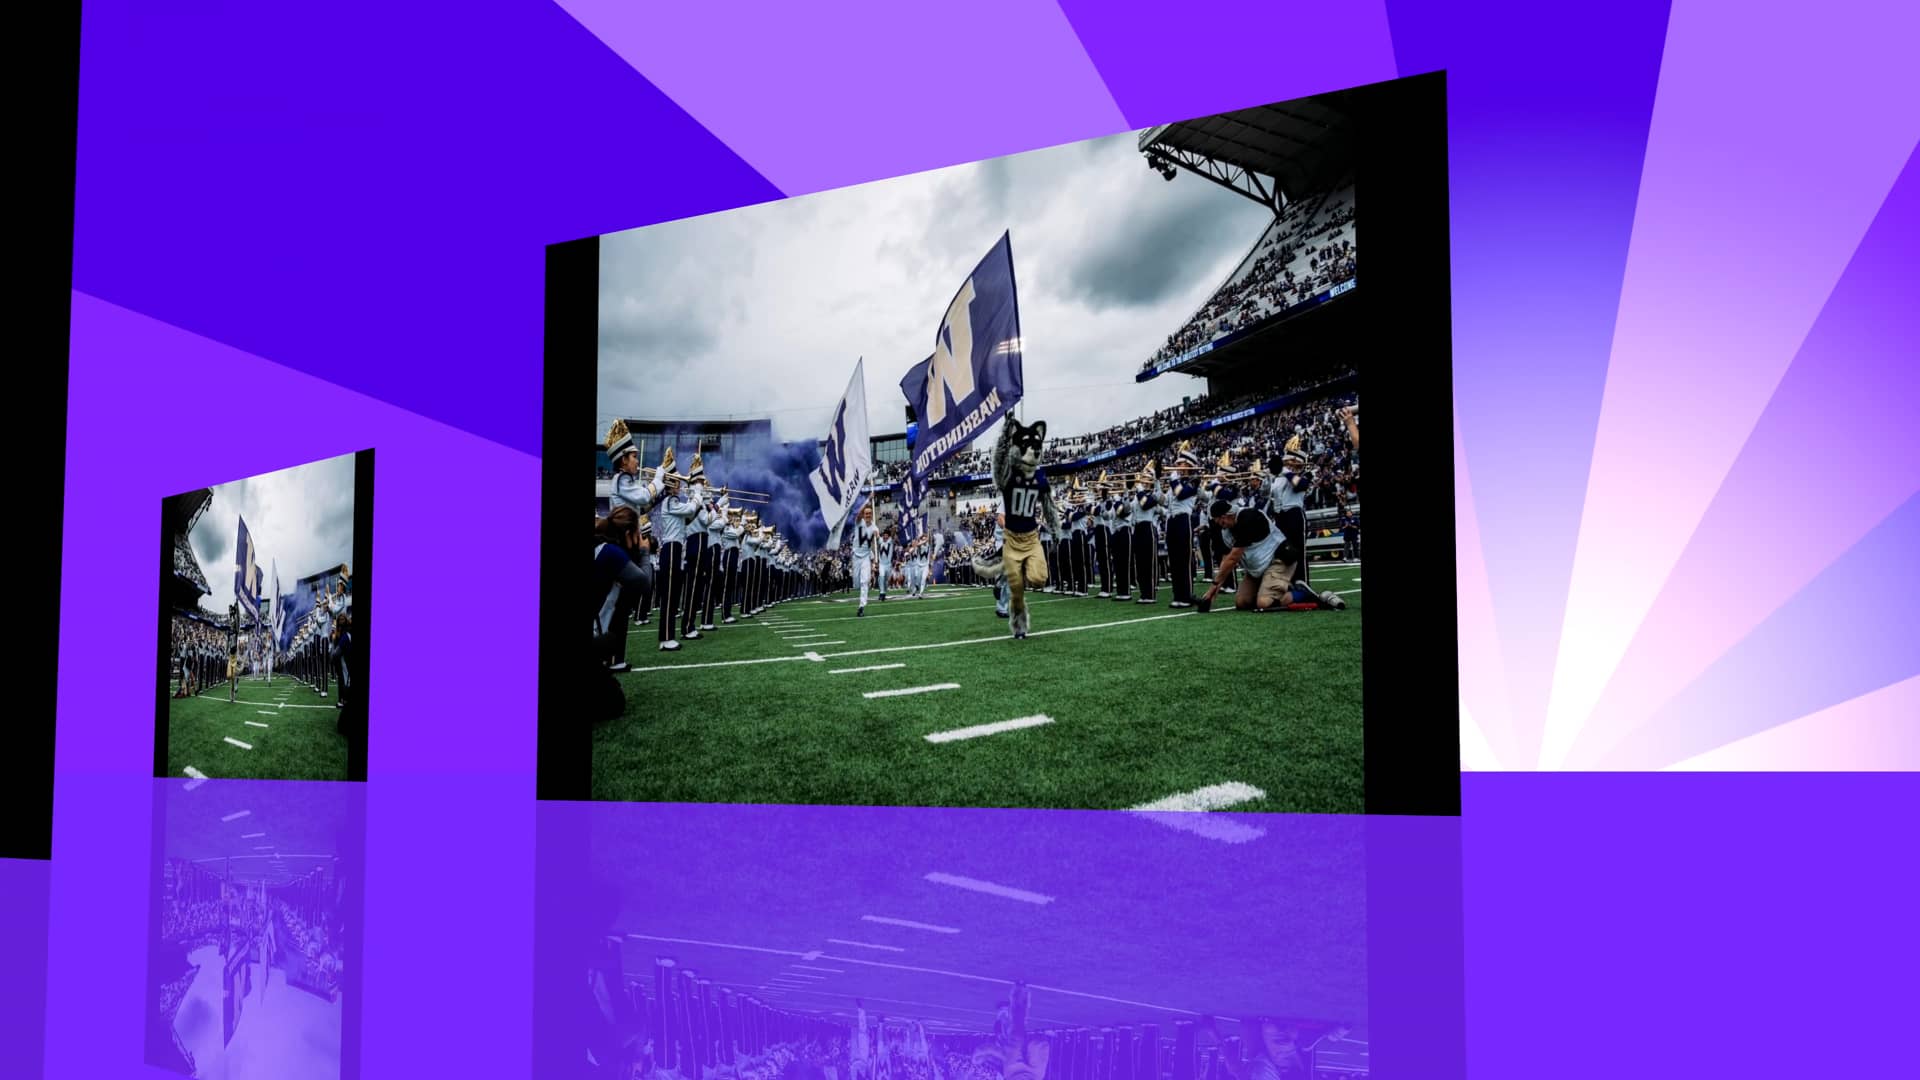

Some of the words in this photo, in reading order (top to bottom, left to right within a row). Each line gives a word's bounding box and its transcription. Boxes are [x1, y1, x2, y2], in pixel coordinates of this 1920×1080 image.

[1011, 488, 1039, 517] 00
[859, 526, 875, 549] W
[880, 543, 891, 558] W
